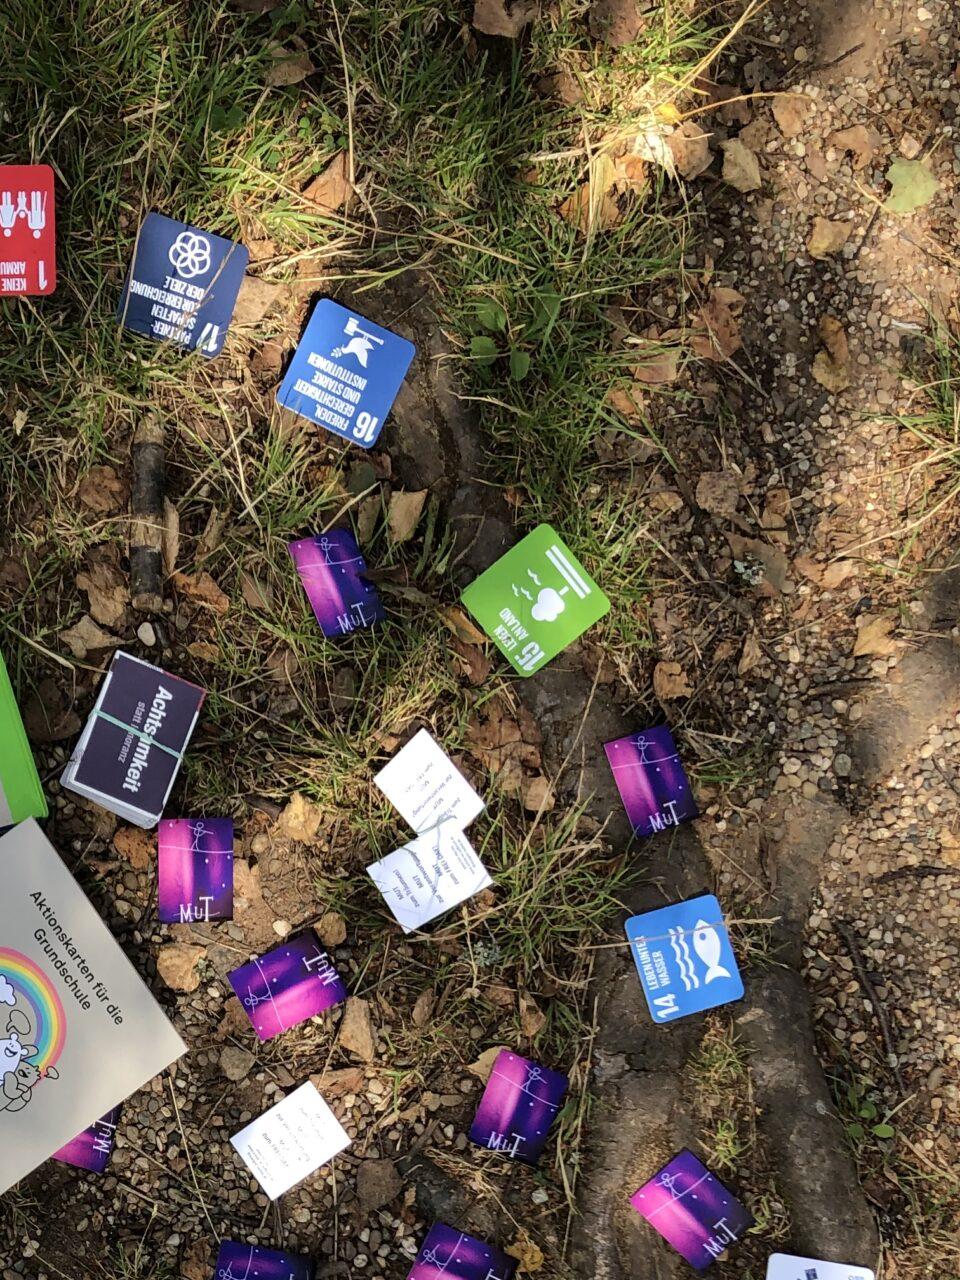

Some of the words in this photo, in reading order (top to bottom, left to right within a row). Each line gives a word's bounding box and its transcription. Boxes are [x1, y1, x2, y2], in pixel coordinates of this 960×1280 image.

[1, 278, 26, 291] KEINE
[38, 260, 48, 290] 1
[163, 276, 188, 295] ZIELE
[129, 280, 183, 309] ERREICHUNG
[186, 284, 205, 301] DER
[196, 322, 220, 352] 17
[307, 352, 367, 390] INSTITUTIONEN
[312, 370, 344, 395] STARKE
[293, 378, 355, 417] GERECHTIGKEIT
[342, 386, 361, 404] UND
[314, 404, 349, 431] FRIEDEN,
[352, 412, 378, 442] 16
[499, 608, 520, 631] LAND
[514, 626, 529, 640] AN
[514, 642, 545, 671] 15
[132, 701, 146, 724] statt
[118, 723, 139, 764] Inoranz
[29, 891, 94, 983] Aktionskarten
[92, 982, 110, 1002] für
[106, 1004, 123, 1025] die
[34, 928, 91, 1010] Grundschule
[652, 951, 670, 986] WASSER
[643, 963, 659, 990] LEBEN
[653, 994, 679, 1018] 14
